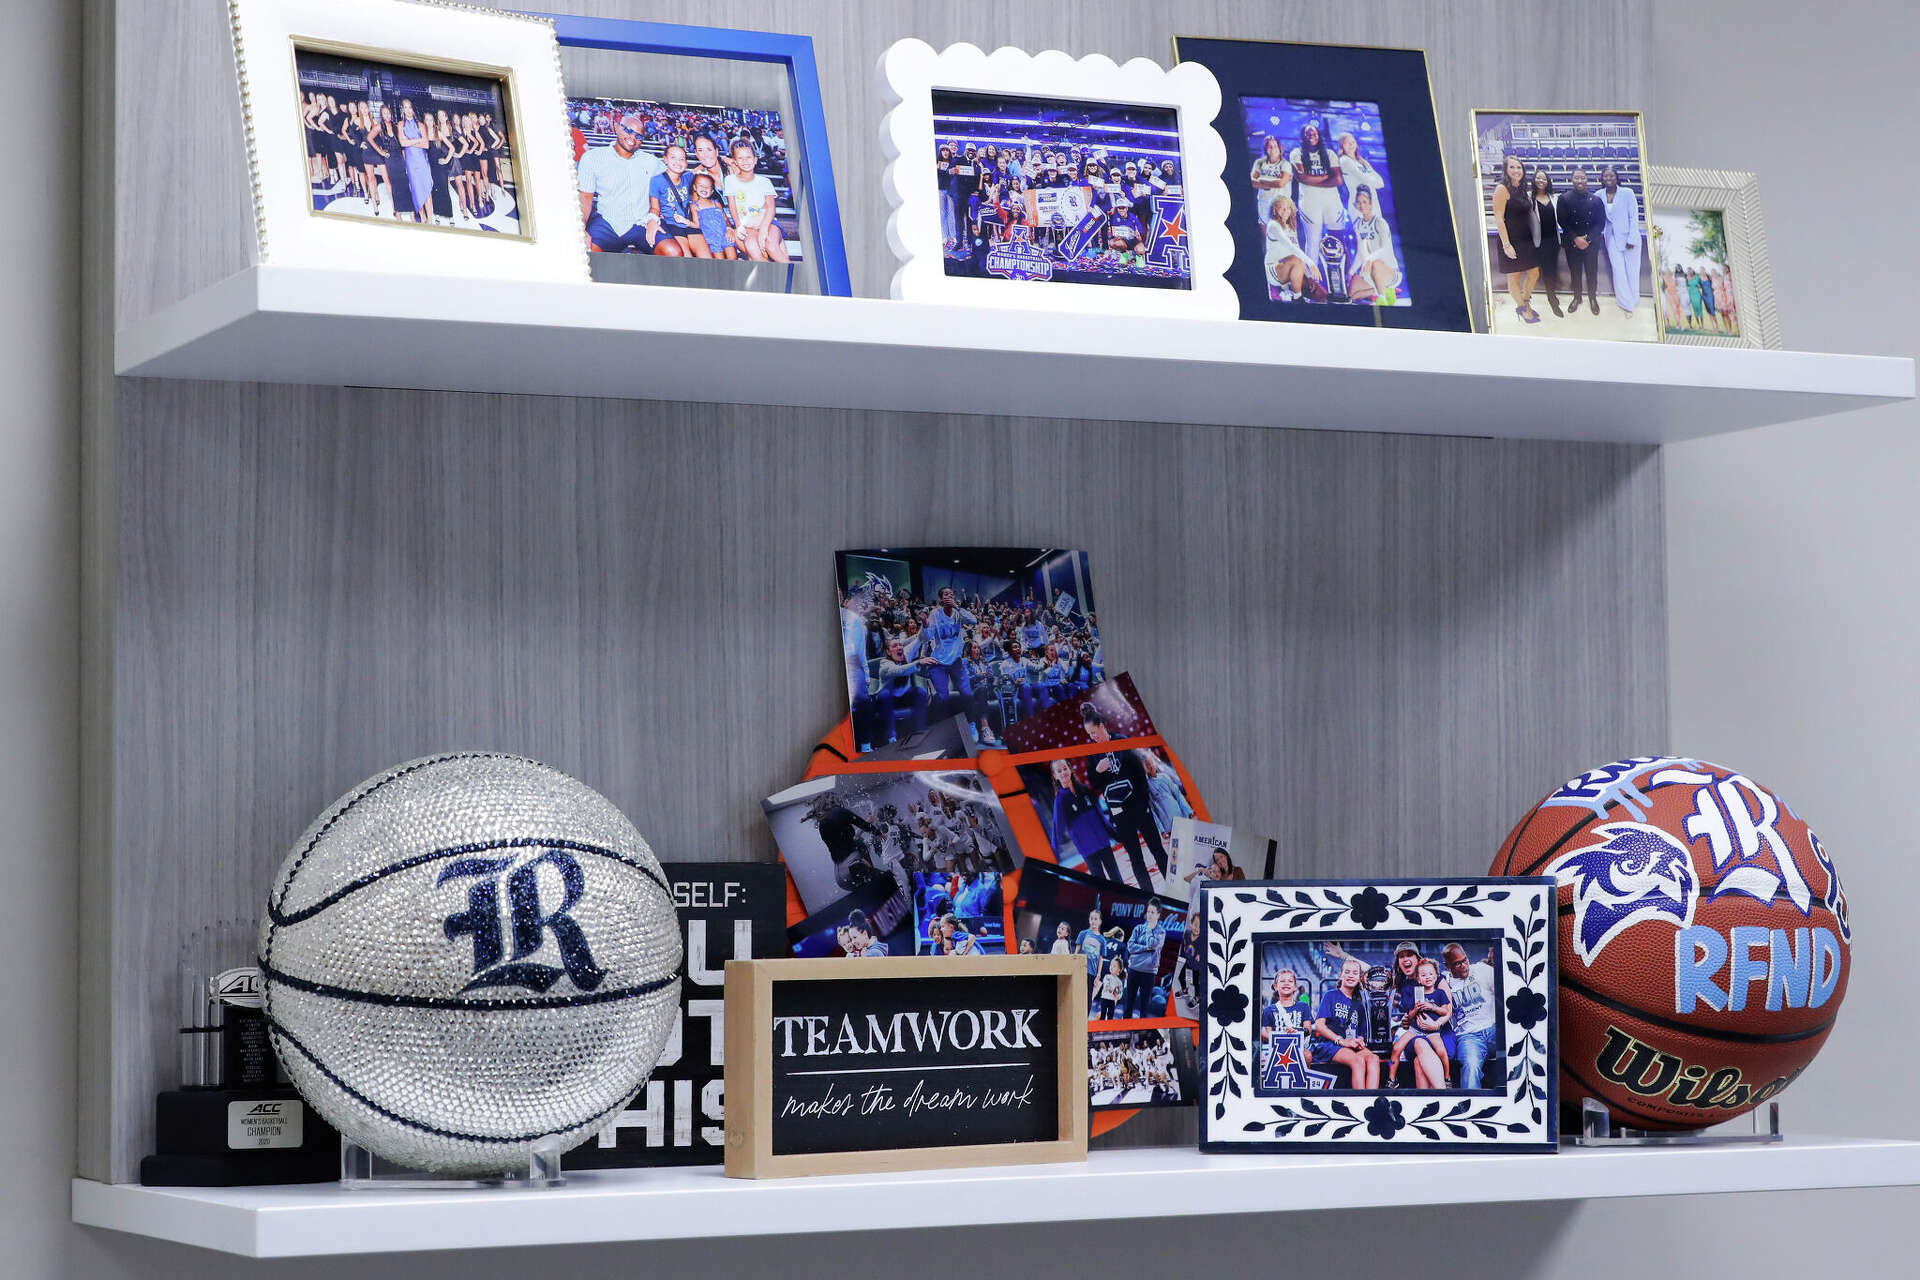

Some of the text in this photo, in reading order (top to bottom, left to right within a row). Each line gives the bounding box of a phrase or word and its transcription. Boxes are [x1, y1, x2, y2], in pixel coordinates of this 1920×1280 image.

[990, 256, 1050, 276] CHAMPIONSHIP
[1193, 836, 1228, 849] AMERICAN
[1111, 902, 1146, 918] PONY UP
[1675, 926, 1842, 1014] RFND
[773, 1009, 1042, 1057] TEAMWORK
[781, 1074, 1034, 1119] makes the dream work
[250, 1103, 282, 1113] ACC
[247, 1126, 281, 1137] CHAMPION
